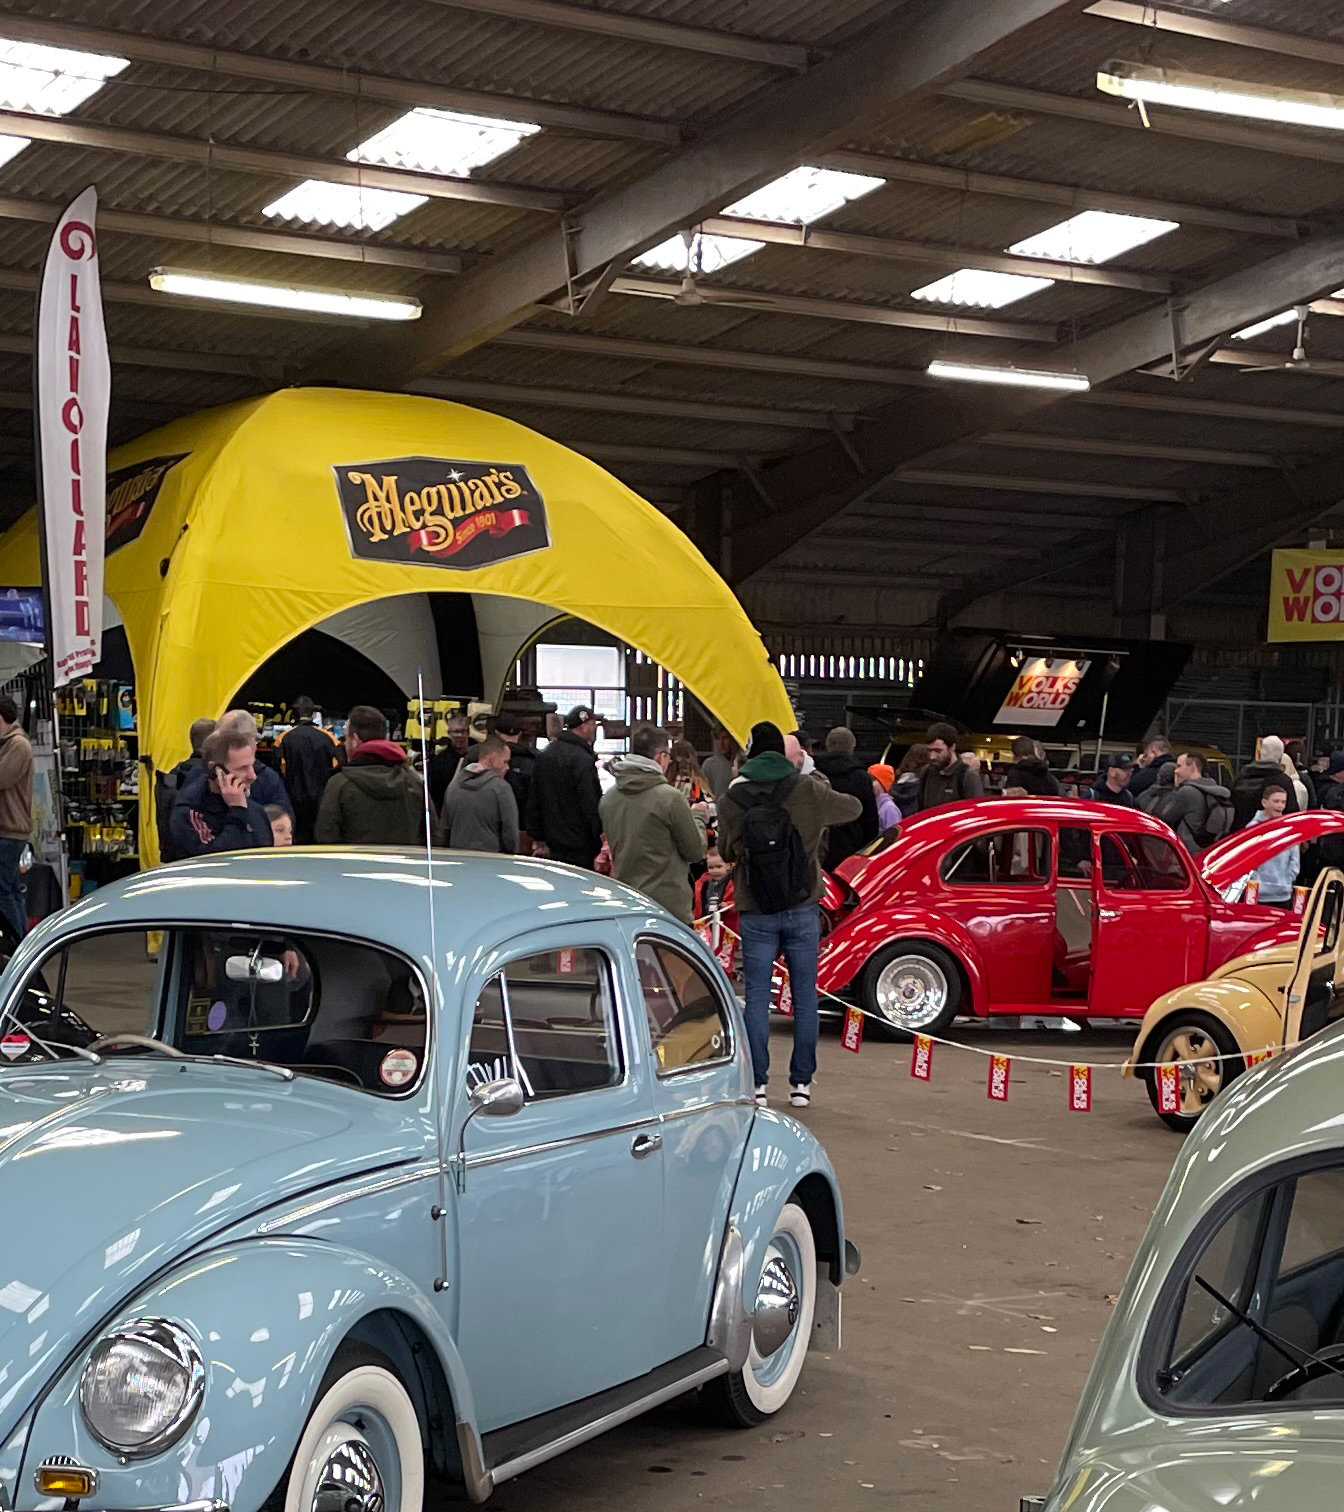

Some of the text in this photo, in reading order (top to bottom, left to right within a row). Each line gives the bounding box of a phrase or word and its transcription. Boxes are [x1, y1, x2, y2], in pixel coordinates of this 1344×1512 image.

[348, 468, 522, 551] Meguiar's
[475, 512, 497, 530] 1901
[1018, 675, 1080, 694] VOLKS
[1005, 691, 1071, 708] WORLD
